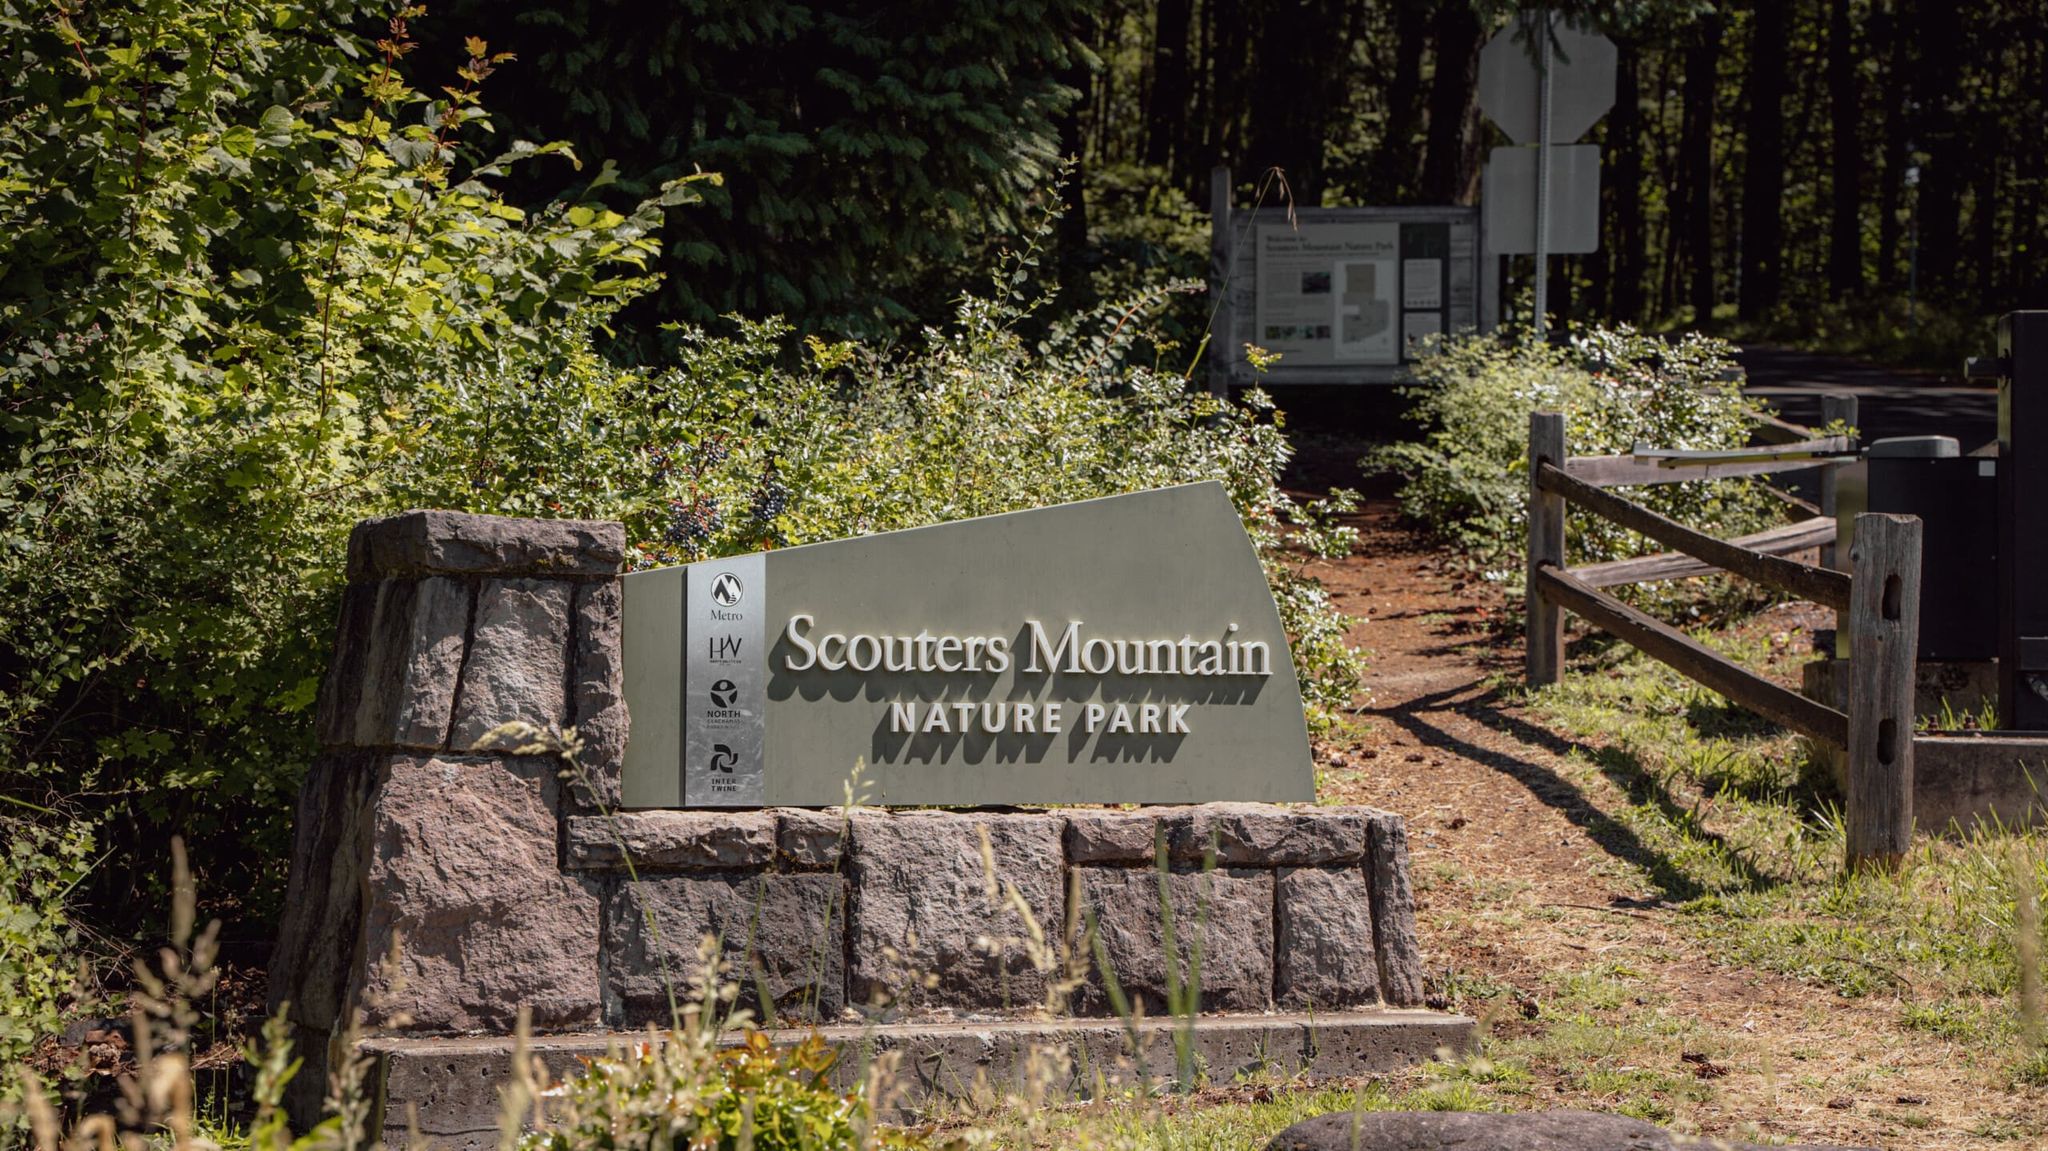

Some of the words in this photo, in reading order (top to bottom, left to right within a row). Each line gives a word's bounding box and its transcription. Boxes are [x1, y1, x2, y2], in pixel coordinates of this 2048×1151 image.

[710, 609, 743, 621] Metro
[785, 614, 1009, 674] Scouters
[1022, 620, 1273, 676] Mountain
[707, 710, 741, 718] NORTH
[891, 701, 1063, 733] NATURE
[1085, 703, 1191, 734] PARK
